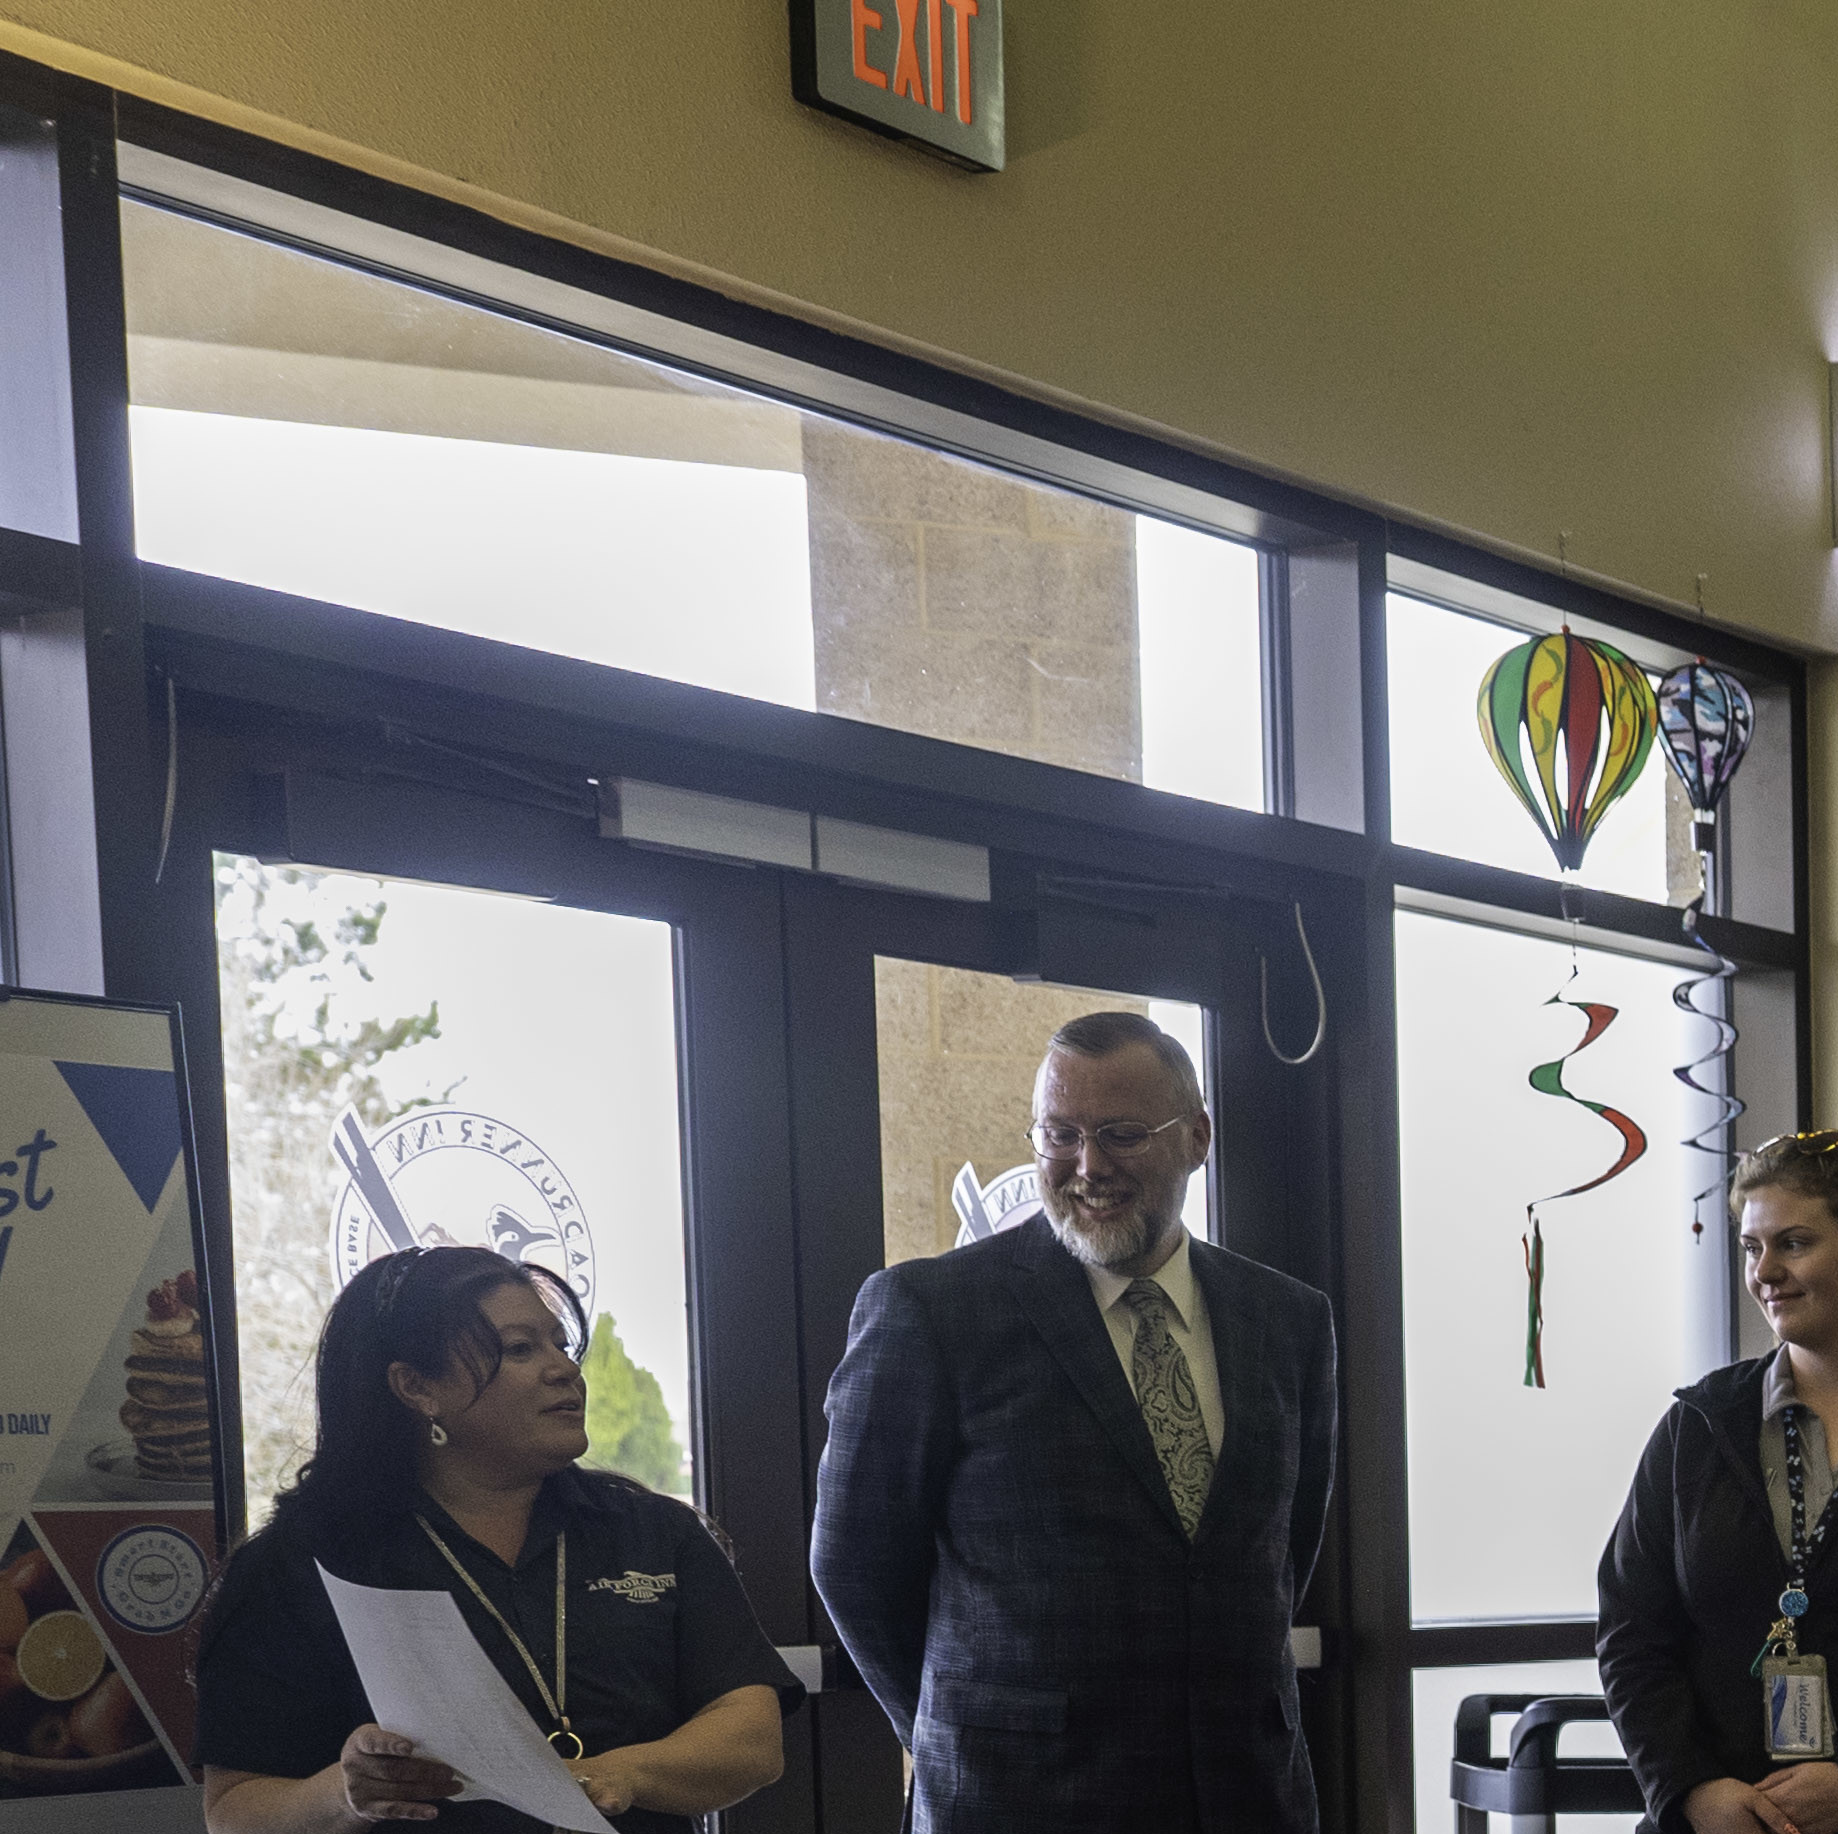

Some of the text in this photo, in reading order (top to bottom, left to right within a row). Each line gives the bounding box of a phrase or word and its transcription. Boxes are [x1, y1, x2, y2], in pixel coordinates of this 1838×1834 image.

[851, 0, 979, 125] EXIT
[8, 1413, 51, 1435] DAILY
[1798, 1683, 1811, 1744] Welcome
